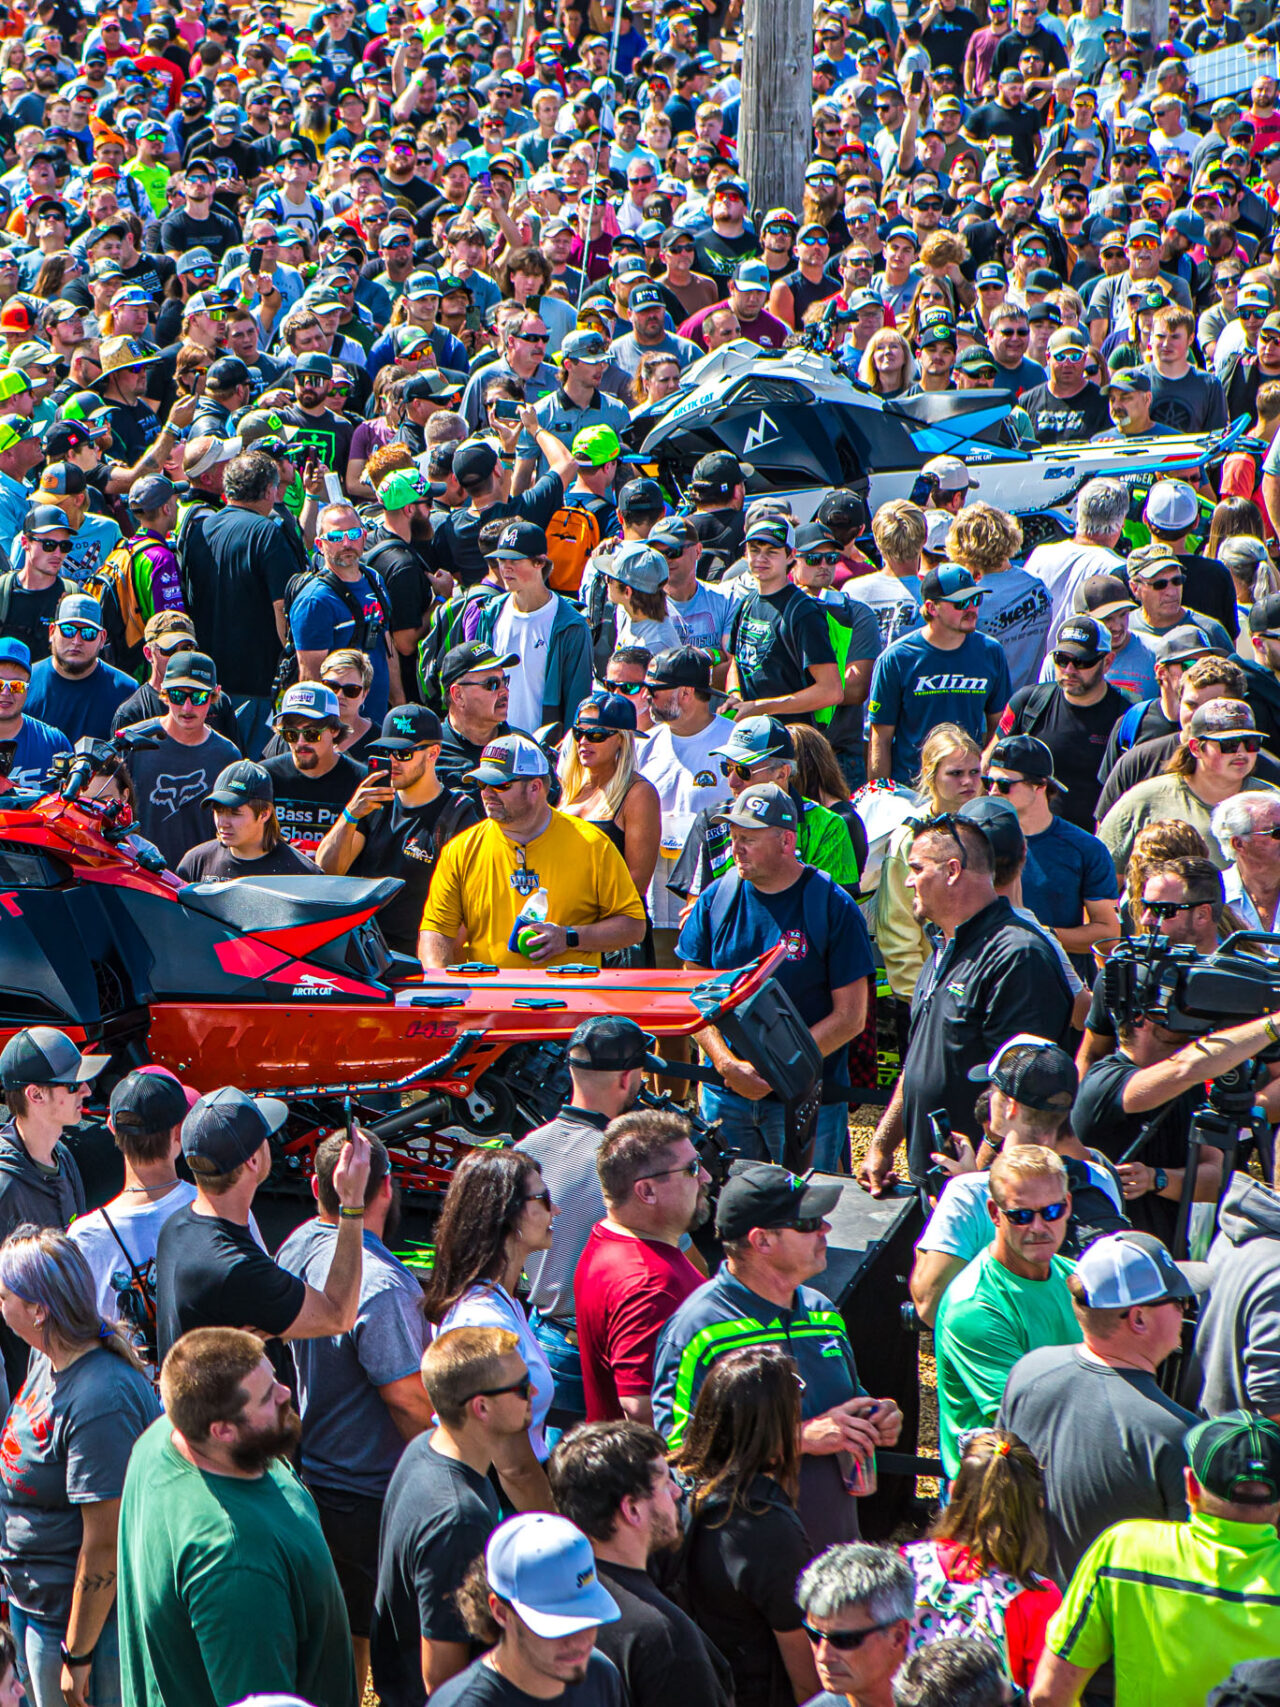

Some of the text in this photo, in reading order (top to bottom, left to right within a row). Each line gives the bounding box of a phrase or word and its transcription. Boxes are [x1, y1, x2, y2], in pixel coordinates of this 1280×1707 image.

[673, 392, 715, 418] ARCTIC CAT
[275, 808, 340, 825] Bass Pr
[280, 826, 326, 846] Shop
[292, 986, 333, 997] ARCTIC CAT
[406, 1021, 460, 1039] 146
